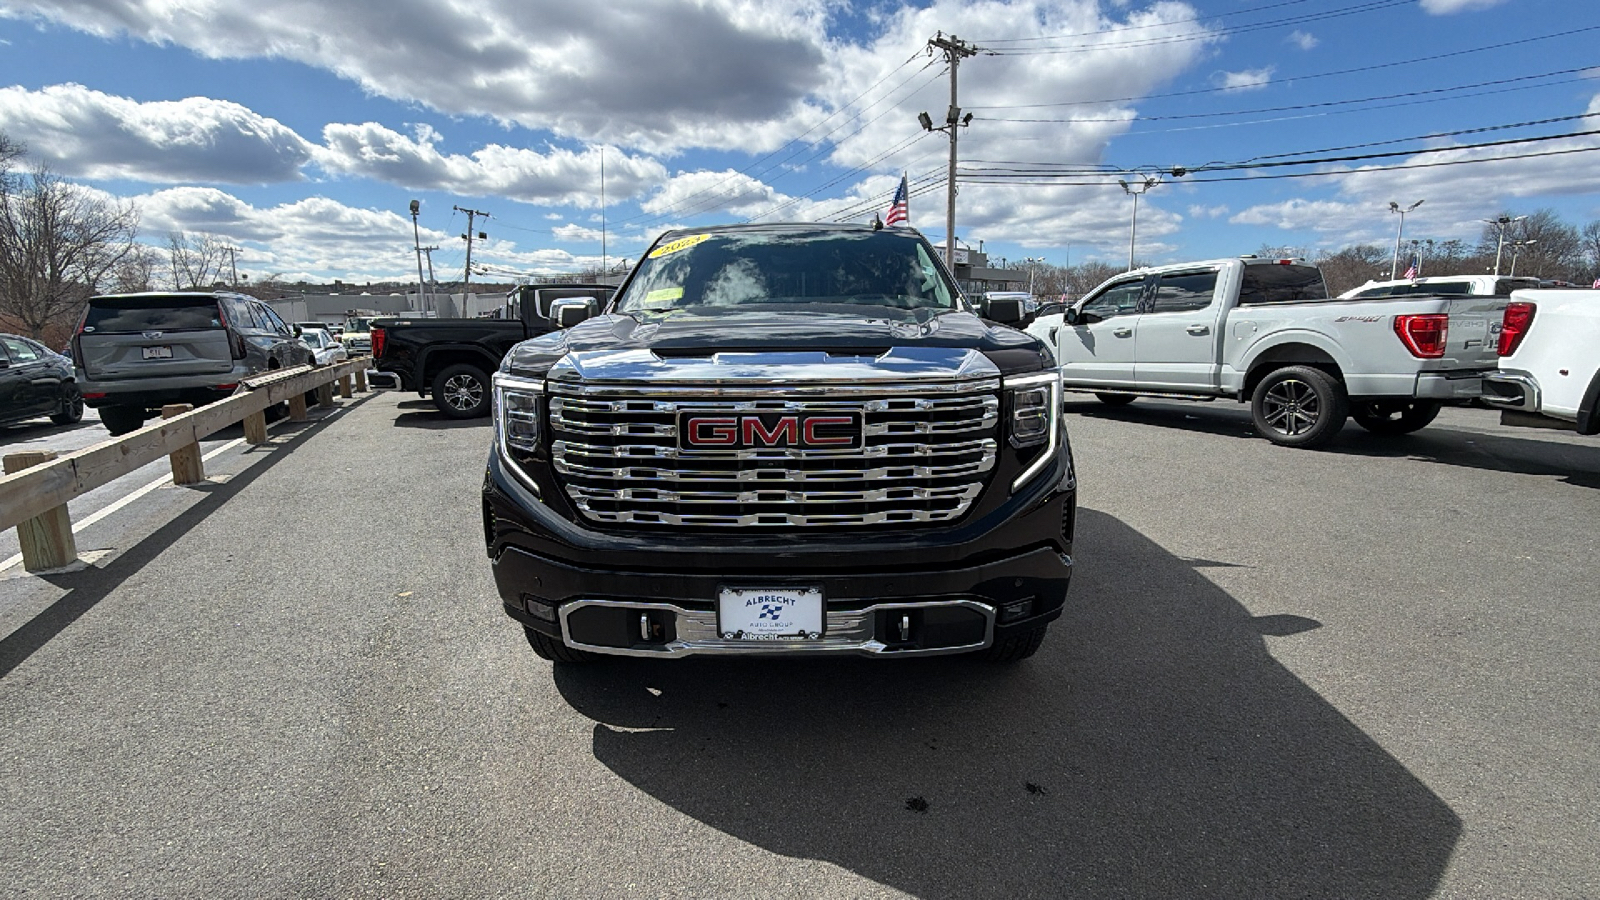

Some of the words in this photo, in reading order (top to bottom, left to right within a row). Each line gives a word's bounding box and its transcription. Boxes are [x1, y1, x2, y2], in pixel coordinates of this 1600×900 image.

[688, 416, 853, 446] GMC
[745, 595, 796, 607] ALBRECHT
[741, 632, 778, 640] Albrecht
